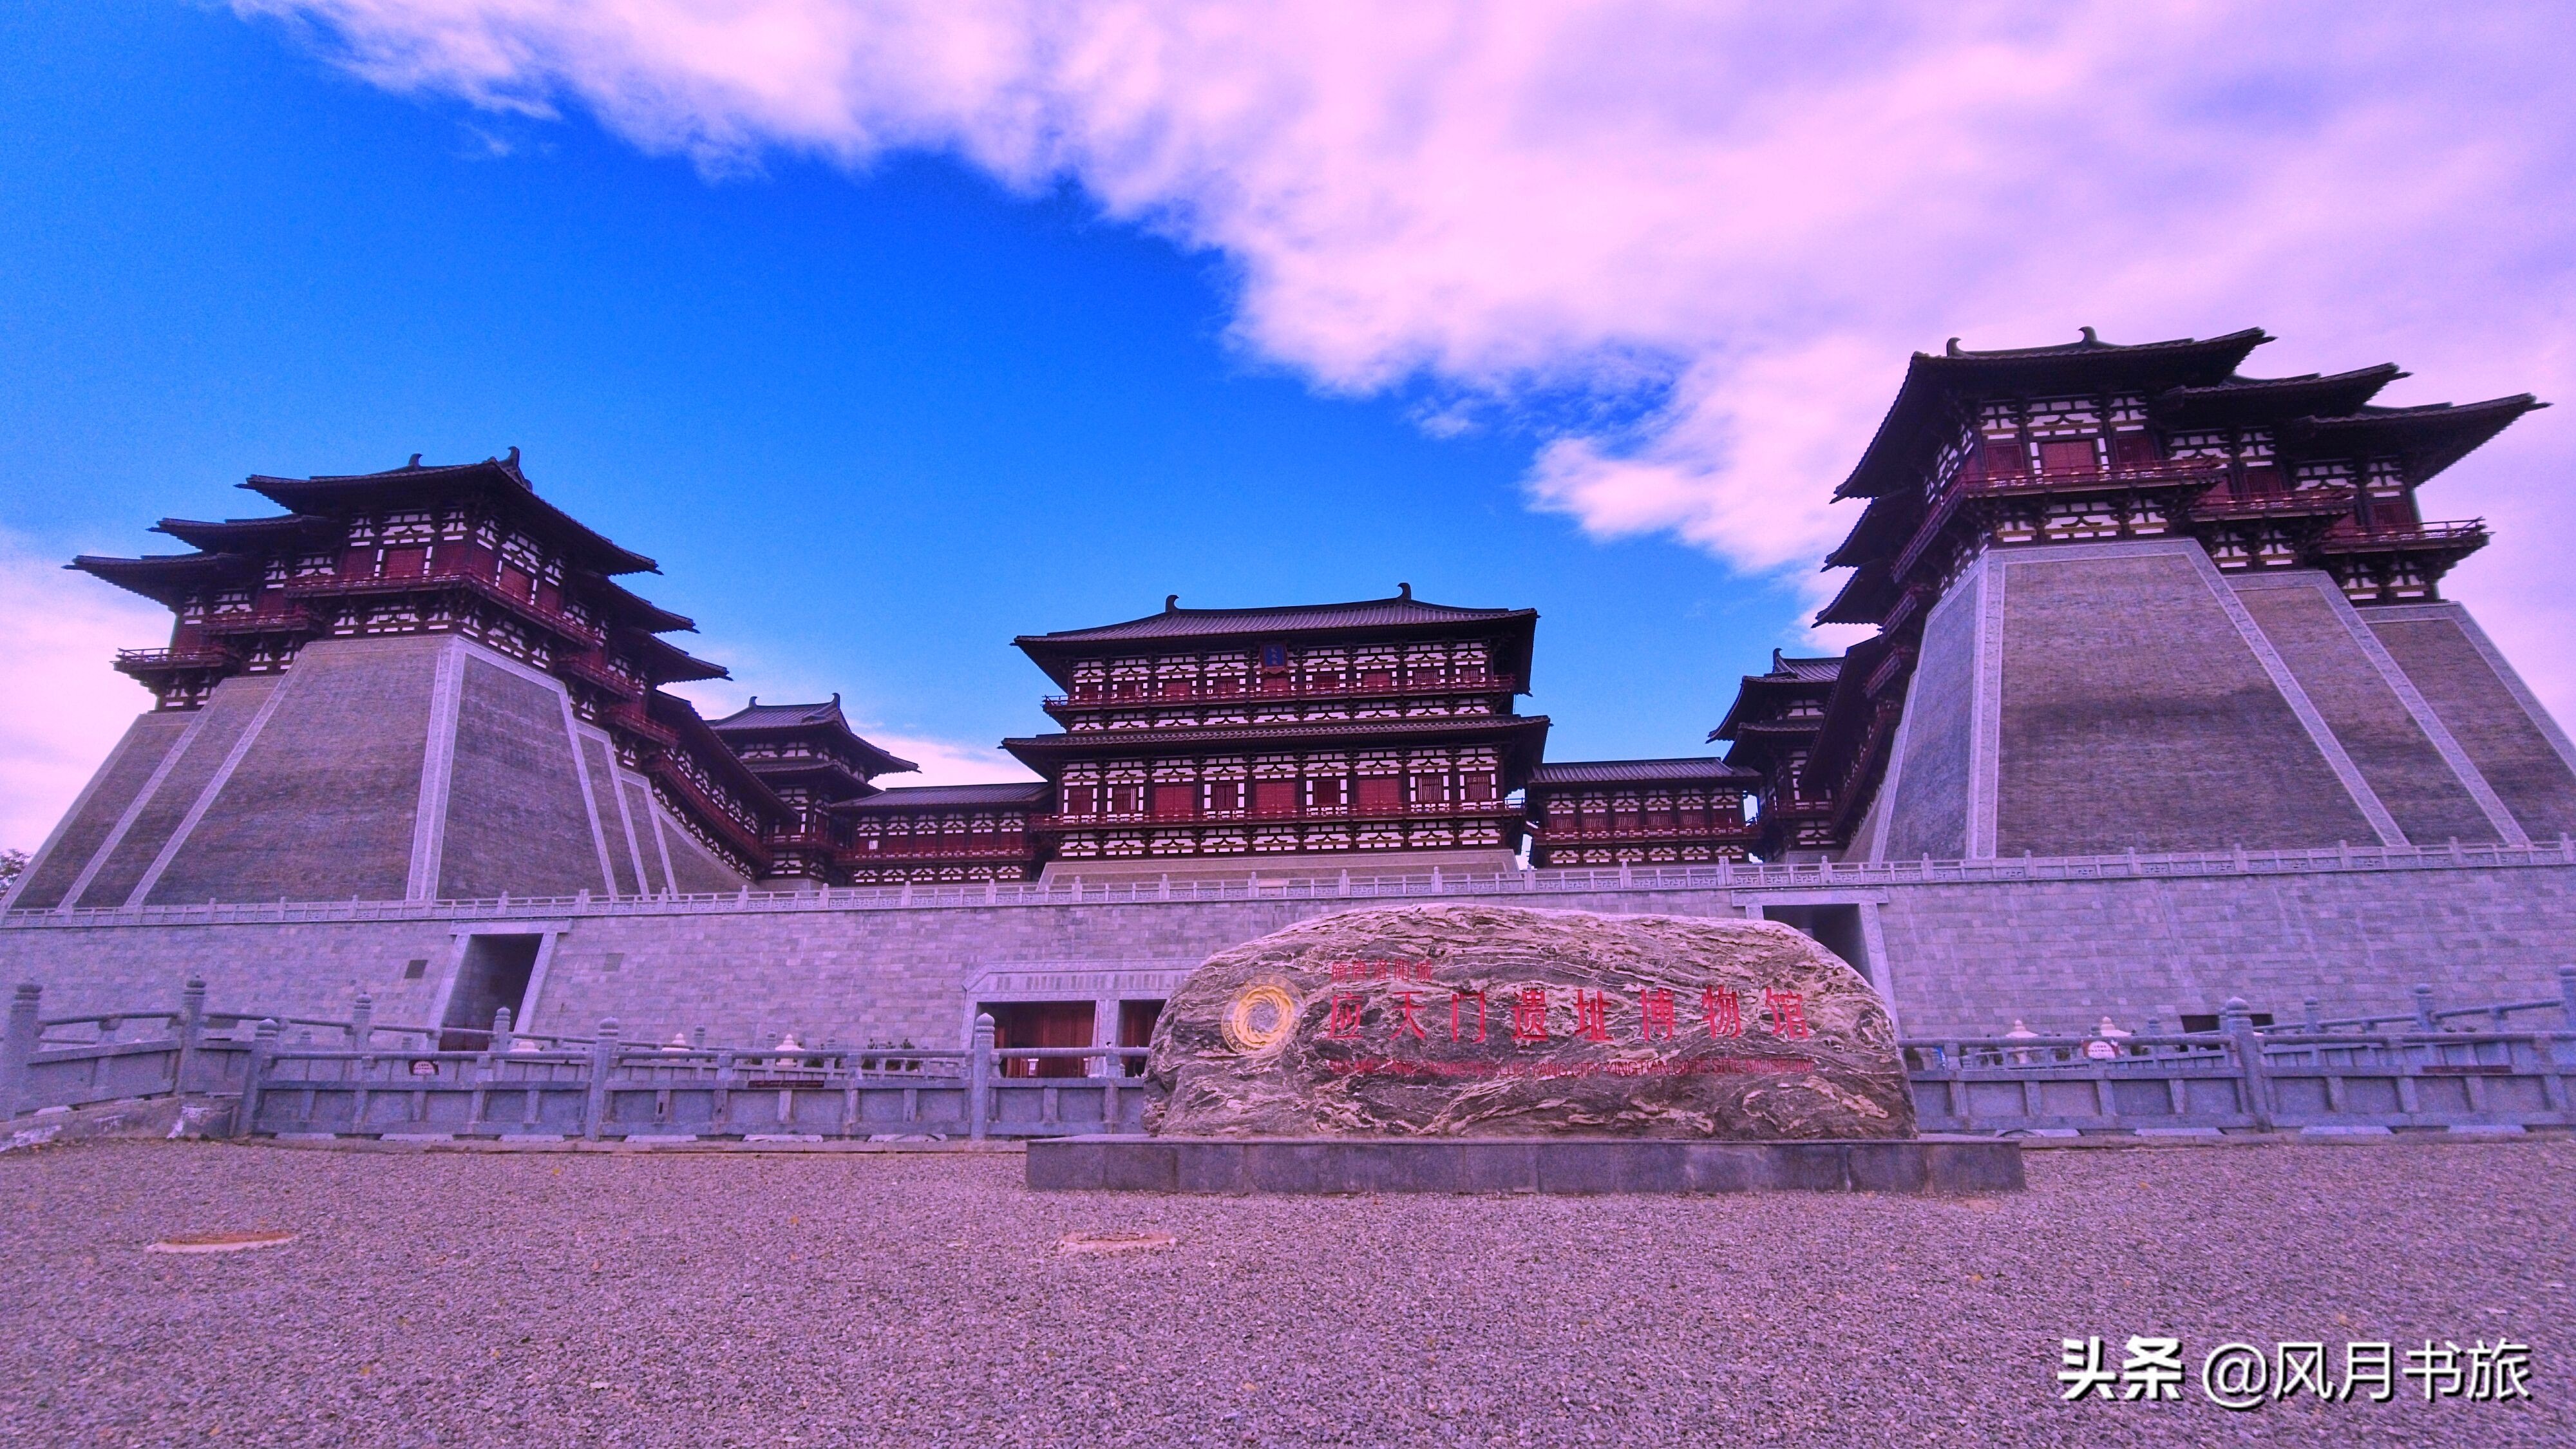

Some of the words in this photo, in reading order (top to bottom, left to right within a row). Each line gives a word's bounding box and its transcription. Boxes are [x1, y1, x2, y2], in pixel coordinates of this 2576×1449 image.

[1328, 985, 1810, 1043] 应天门遗址博物馆
[1531, 1063, 1567, 1076] YANG
[1571, 1063, 1601, 1077] CITY
[1710, 1058, 1743, 1074] SITE
[1745, 1058, 1814, 1073] MUSEUM
